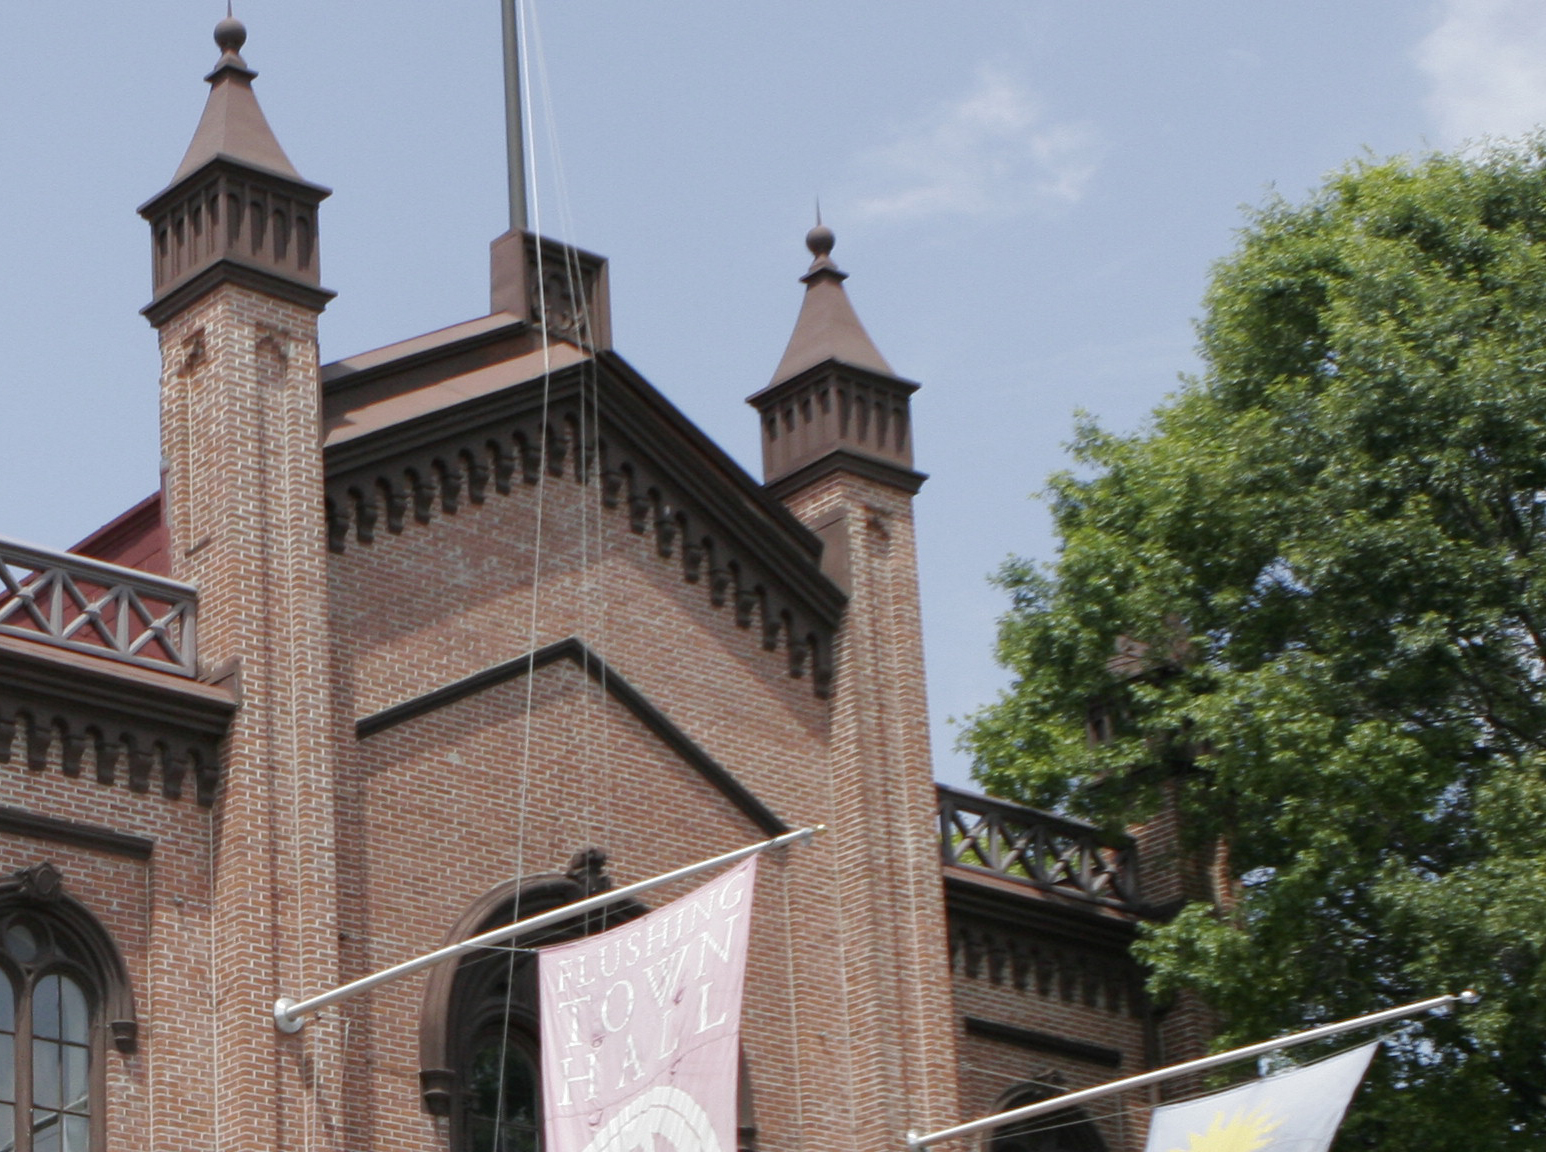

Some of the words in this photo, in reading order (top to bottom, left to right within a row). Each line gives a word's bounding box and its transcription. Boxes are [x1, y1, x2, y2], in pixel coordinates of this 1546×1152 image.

[558, 873, 745, 992] FLUSHING
[558, 913, 740, 1048] TOWN
[557, 982, 727, 1106] HALL
